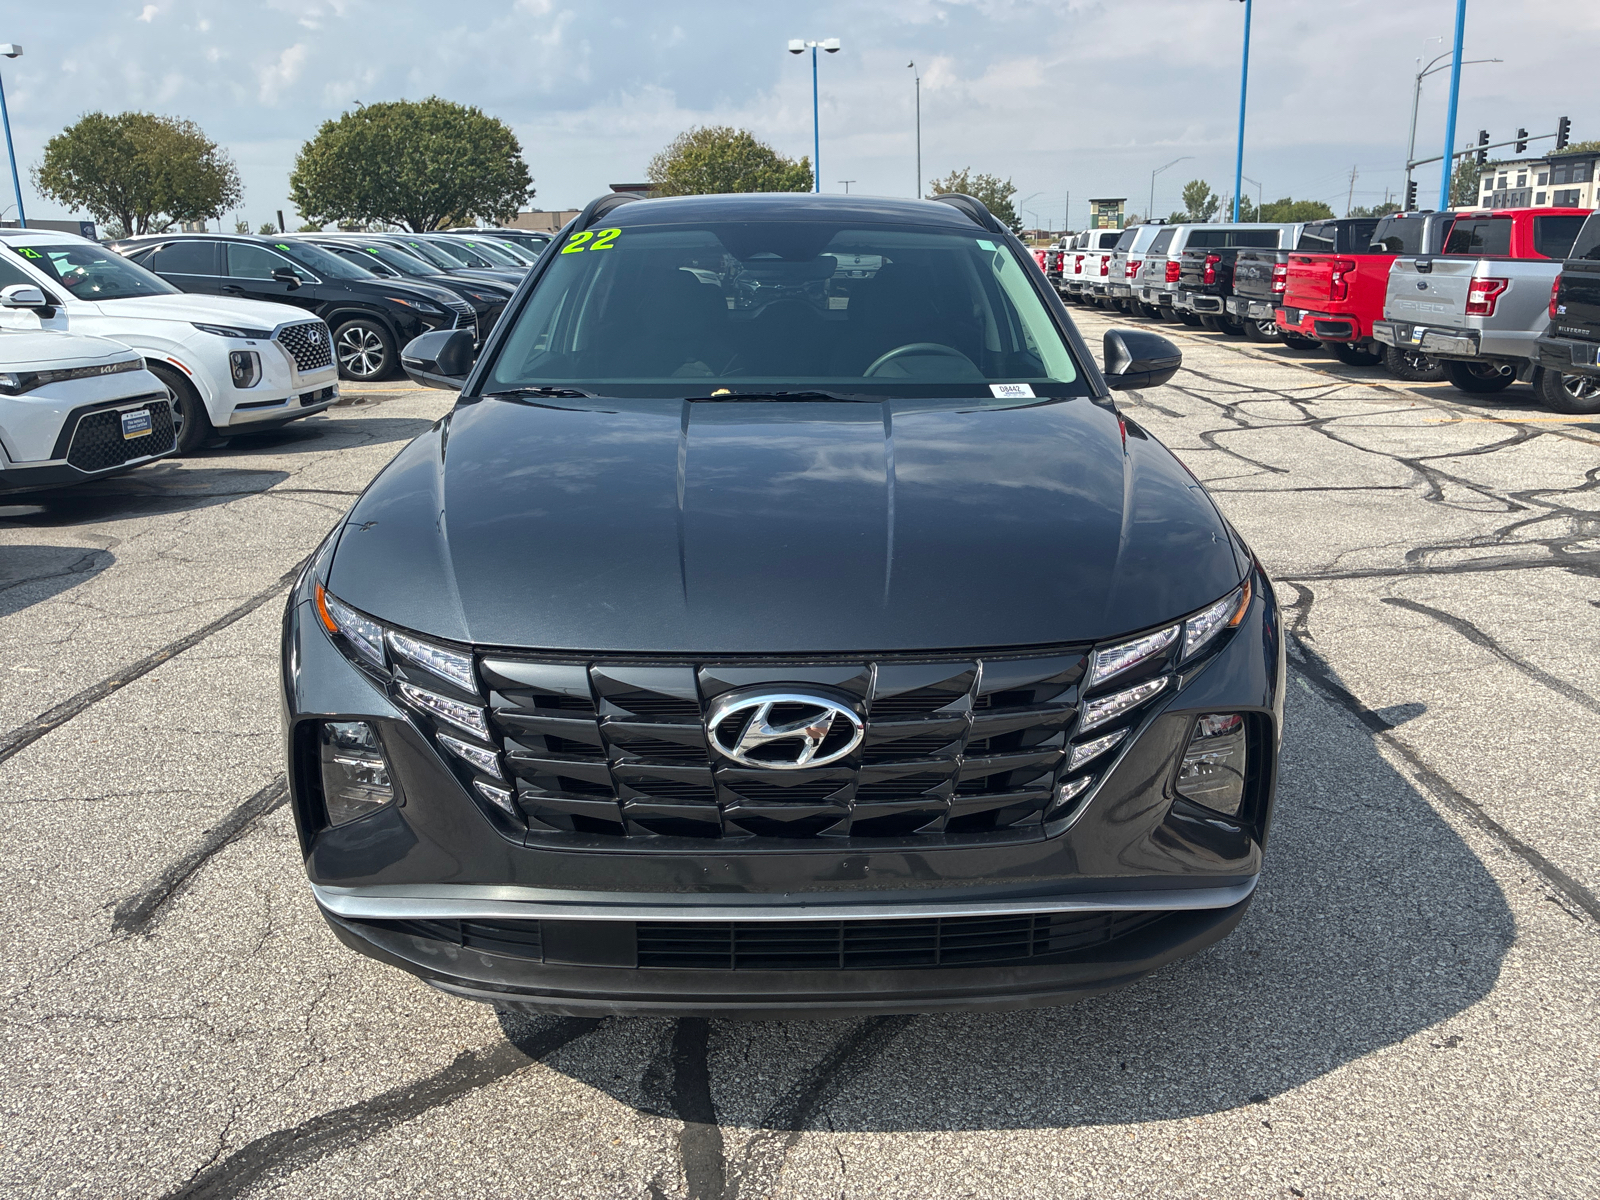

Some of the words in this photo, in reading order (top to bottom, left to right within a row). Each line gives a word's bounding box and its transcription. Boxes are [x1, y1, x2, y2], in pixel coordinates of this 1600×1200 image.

[561, 228, 622, 255] 22
[18, 248, 43, 259] 21
[1399, 301, 1445, 314] F-150
[1558, 325, 1591, 335] SILVERADO
